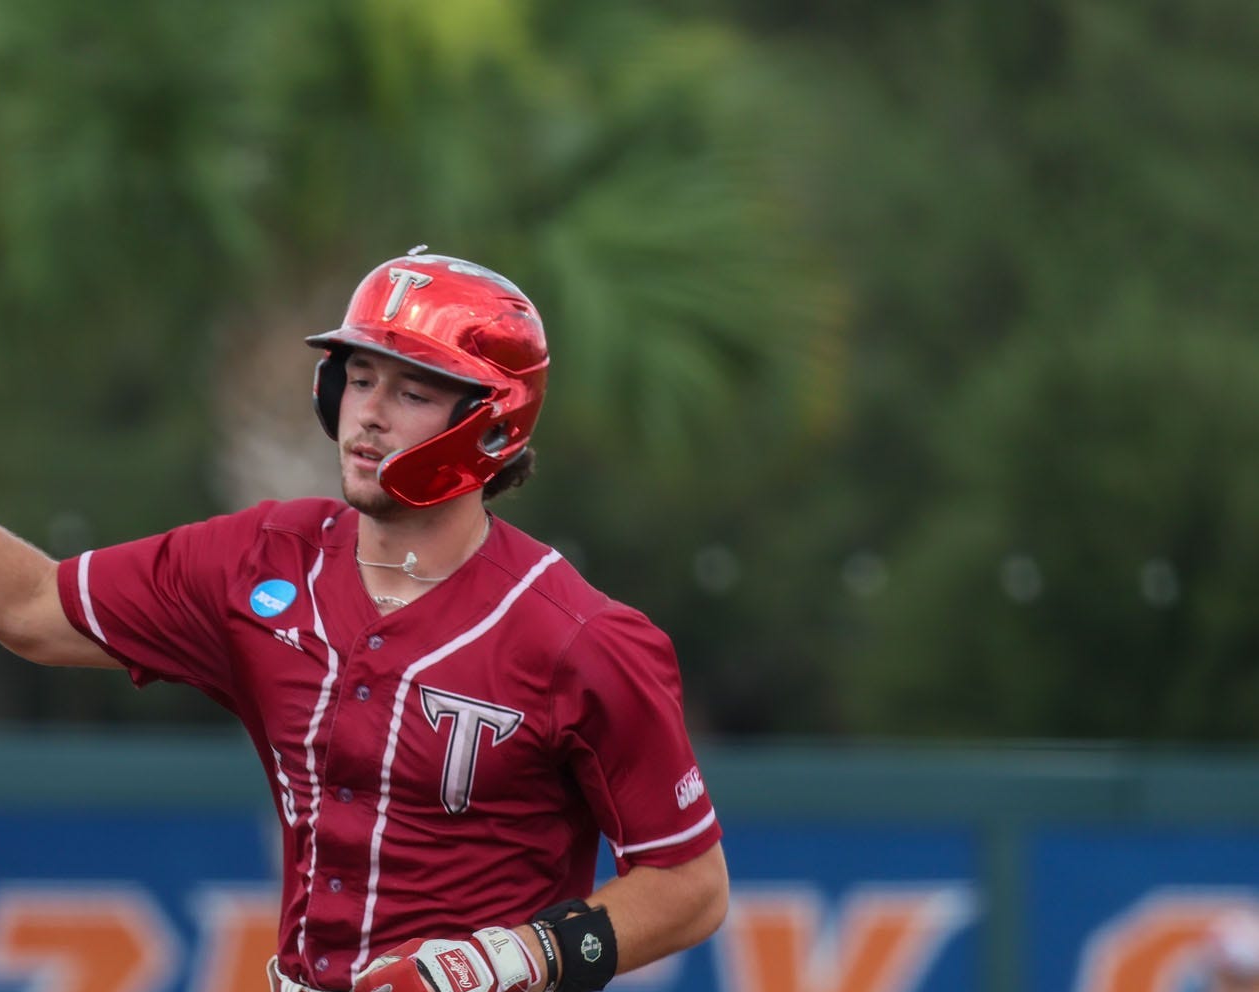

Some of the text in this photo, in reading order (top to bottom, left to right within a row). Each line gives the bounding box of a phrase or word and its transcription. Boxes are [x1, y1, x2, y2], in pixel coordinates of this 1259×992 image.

[383, 267, 433, 321] T
[419, 685, 525, 816] T
[542, 938, 555, 961] LEAVE
